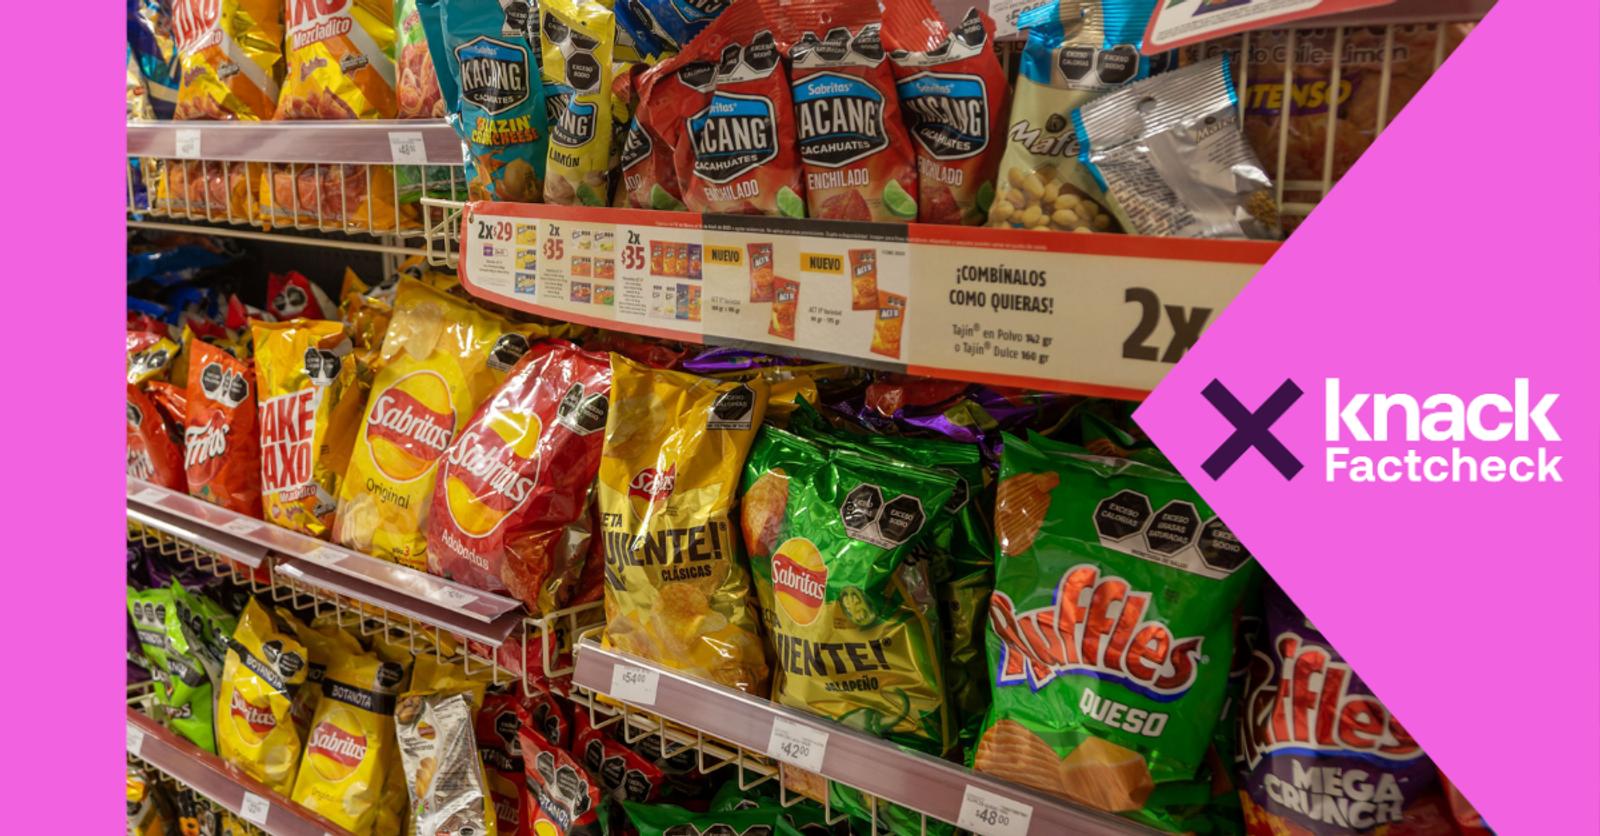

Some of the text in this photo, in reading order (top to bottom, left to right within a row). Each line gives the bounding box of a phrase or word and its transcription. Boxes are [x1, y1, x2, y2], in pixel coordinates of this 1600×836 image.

[461, 58, 521, 91] KACANG
[808, 83, 850, 96] Sabritas
[796, 97, 877, 139] ACANG
[549, 147, 580, 168] LIMÓN
[808, 168, 870, 190] ENCHILADO
[543, 238, 565, 261] $35
[621, 245, 645, 270] $35
[711, 249, 740, 263] NUEVO
[809, 256, 842, 272] NUEVO
[956, 265, 1047, 287] ¡COMBÍNALOS
[949, 289, 1054, 315] COMO QUIERAS!
[982, 329, 995, 339] en
[997, 328, 1023, 343] Polvo
[1122, 287, 1213, 364] 2x
[954, 343, 961, 353] o
[993, 345, 1019, 360] Dulce
[259, 391, 314, 445] AKE
[368, 396, 451, 452] Sabritas
[184, 418, 230, 470] Fritos
[262, 442, 312, 492] AXO
[449, 431, 534, 502] Sabritas
[366, 477, 411, 510] Original
[1108, 502, 1140, 518] EXCESO
[601, 512, 623, 527] ETA
[441, 529, 489, 570] Adobadas
[661, 564, 713, 582] CLÁSICAS
[772, 560, 825, 600] Sabritas
[988, 564, 1205, 694] Ruffles
[825, 675, 879, 692] JALAPEÑO
[1079, 687, 1169, 738] QUESO
[308, 724, 367, 761] Sabritas
[1292, 759, 1404, 803] MEGA
[1263, 773, 1403, 829] CRUNCH
